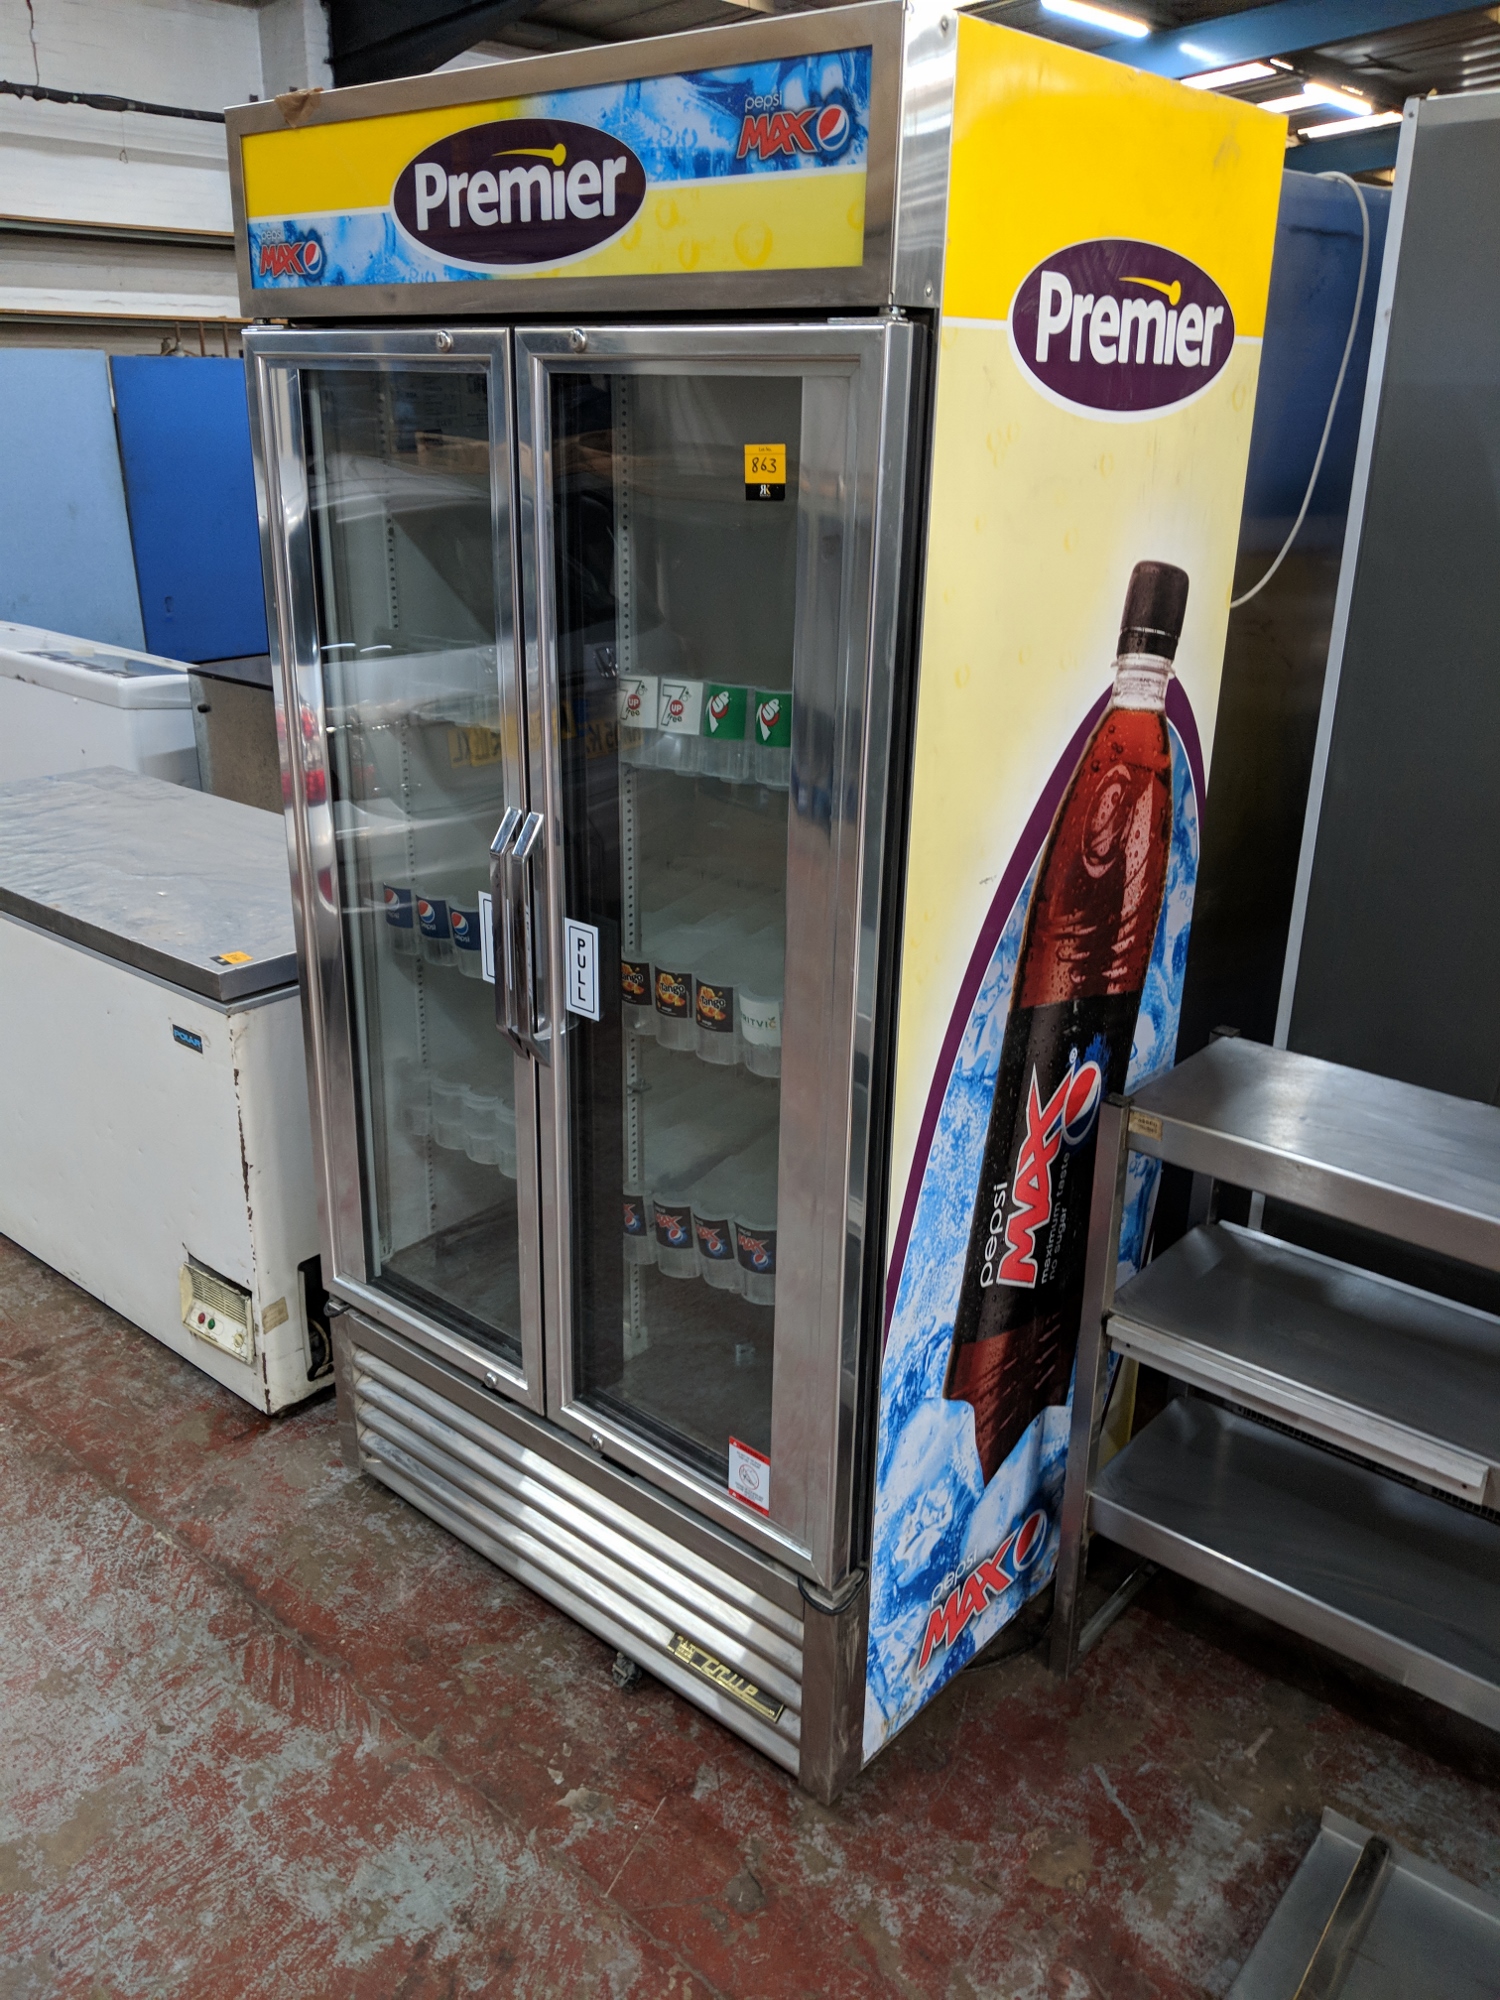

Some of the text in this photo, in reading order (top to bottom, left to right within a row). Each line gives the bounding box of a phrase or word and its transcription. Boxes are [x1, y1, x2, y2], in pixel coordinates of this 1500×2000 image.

[735, 106, 822, 160] MAX
[744, 90, 783, 113] pepsi
[414, 144, 627, 231] Premier
[259, 241, 306, 278] MAX
[1035, 269, 1225, 368] Premier
[752, 457, 776, 474] 863
[576, 937, 586, 1001] PULL
[621, 972, 644, 985] ango
[660, 982, 686, 997] Tango
[701, 996, 726, 1010] Tango
[741, 1012, 777, 1029] RITVIC
[996, 1062, 1075, 1289] MAX
[980, 1181, 1008, 1288] pepsi
[1041, 1152, 1071, 1285] maximum taste
[1049, 1206, 1068, 1281] no sugar
[917, 1525, 1021, 1676] MAX
[930, 1544, 978, 1608] pepsi
